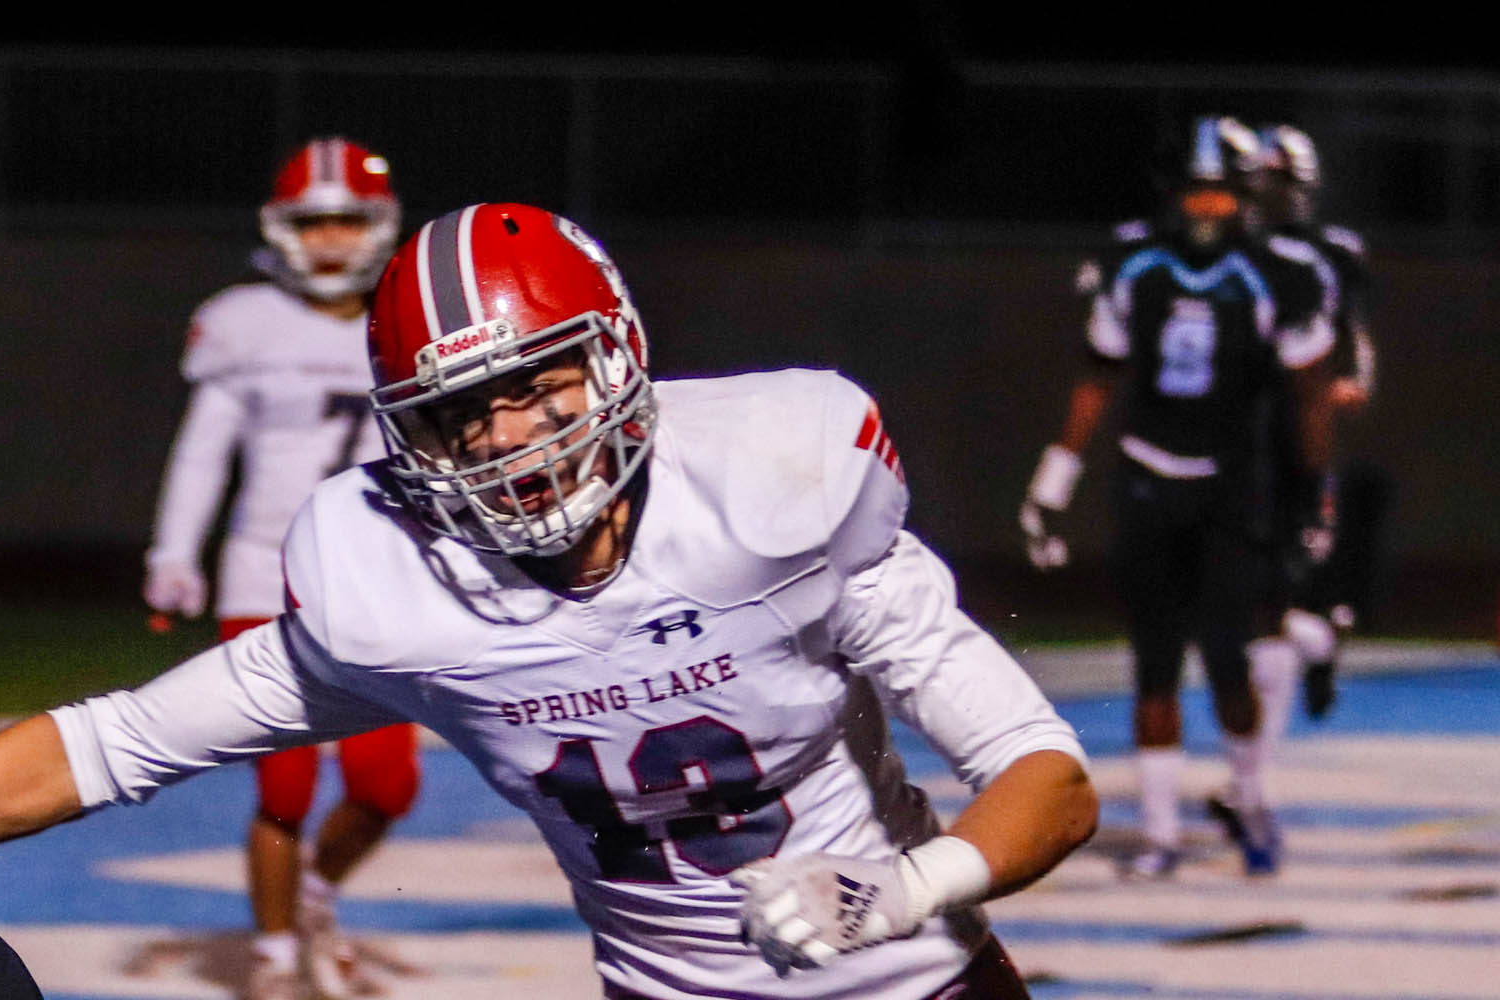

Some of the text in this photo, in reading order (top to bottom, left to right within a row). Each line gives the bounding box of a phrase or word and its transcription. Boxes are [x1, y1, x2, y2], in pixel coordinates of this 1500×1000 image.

[435, 326, 490, 360] Riddell
[500, 652, 738, 726] SPRING LAKE
[534, 714, 796, 885] 13
